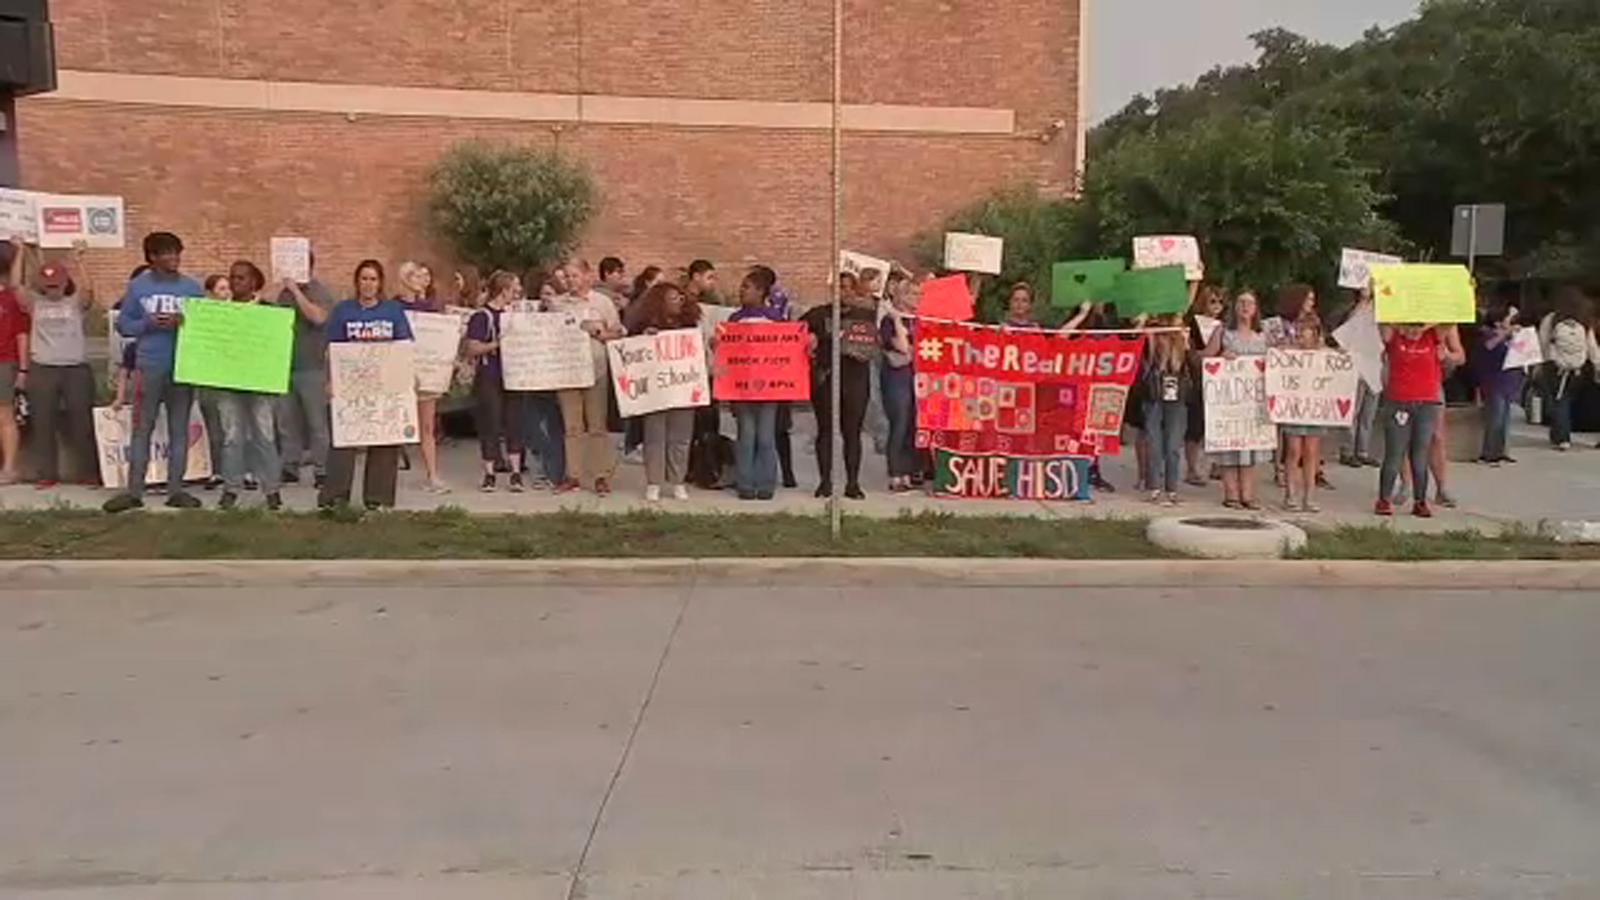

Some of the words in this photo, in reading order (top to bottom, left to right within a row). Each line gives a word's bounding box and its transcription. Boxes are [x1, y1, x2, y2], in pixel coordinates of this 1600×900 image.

[1325, 353, 1354, 373] ROB
[1282, 374, 1301, 391] US
[945, 456, 1009, 496] SAVE
[1016, 459, 1078, 498] HISD
